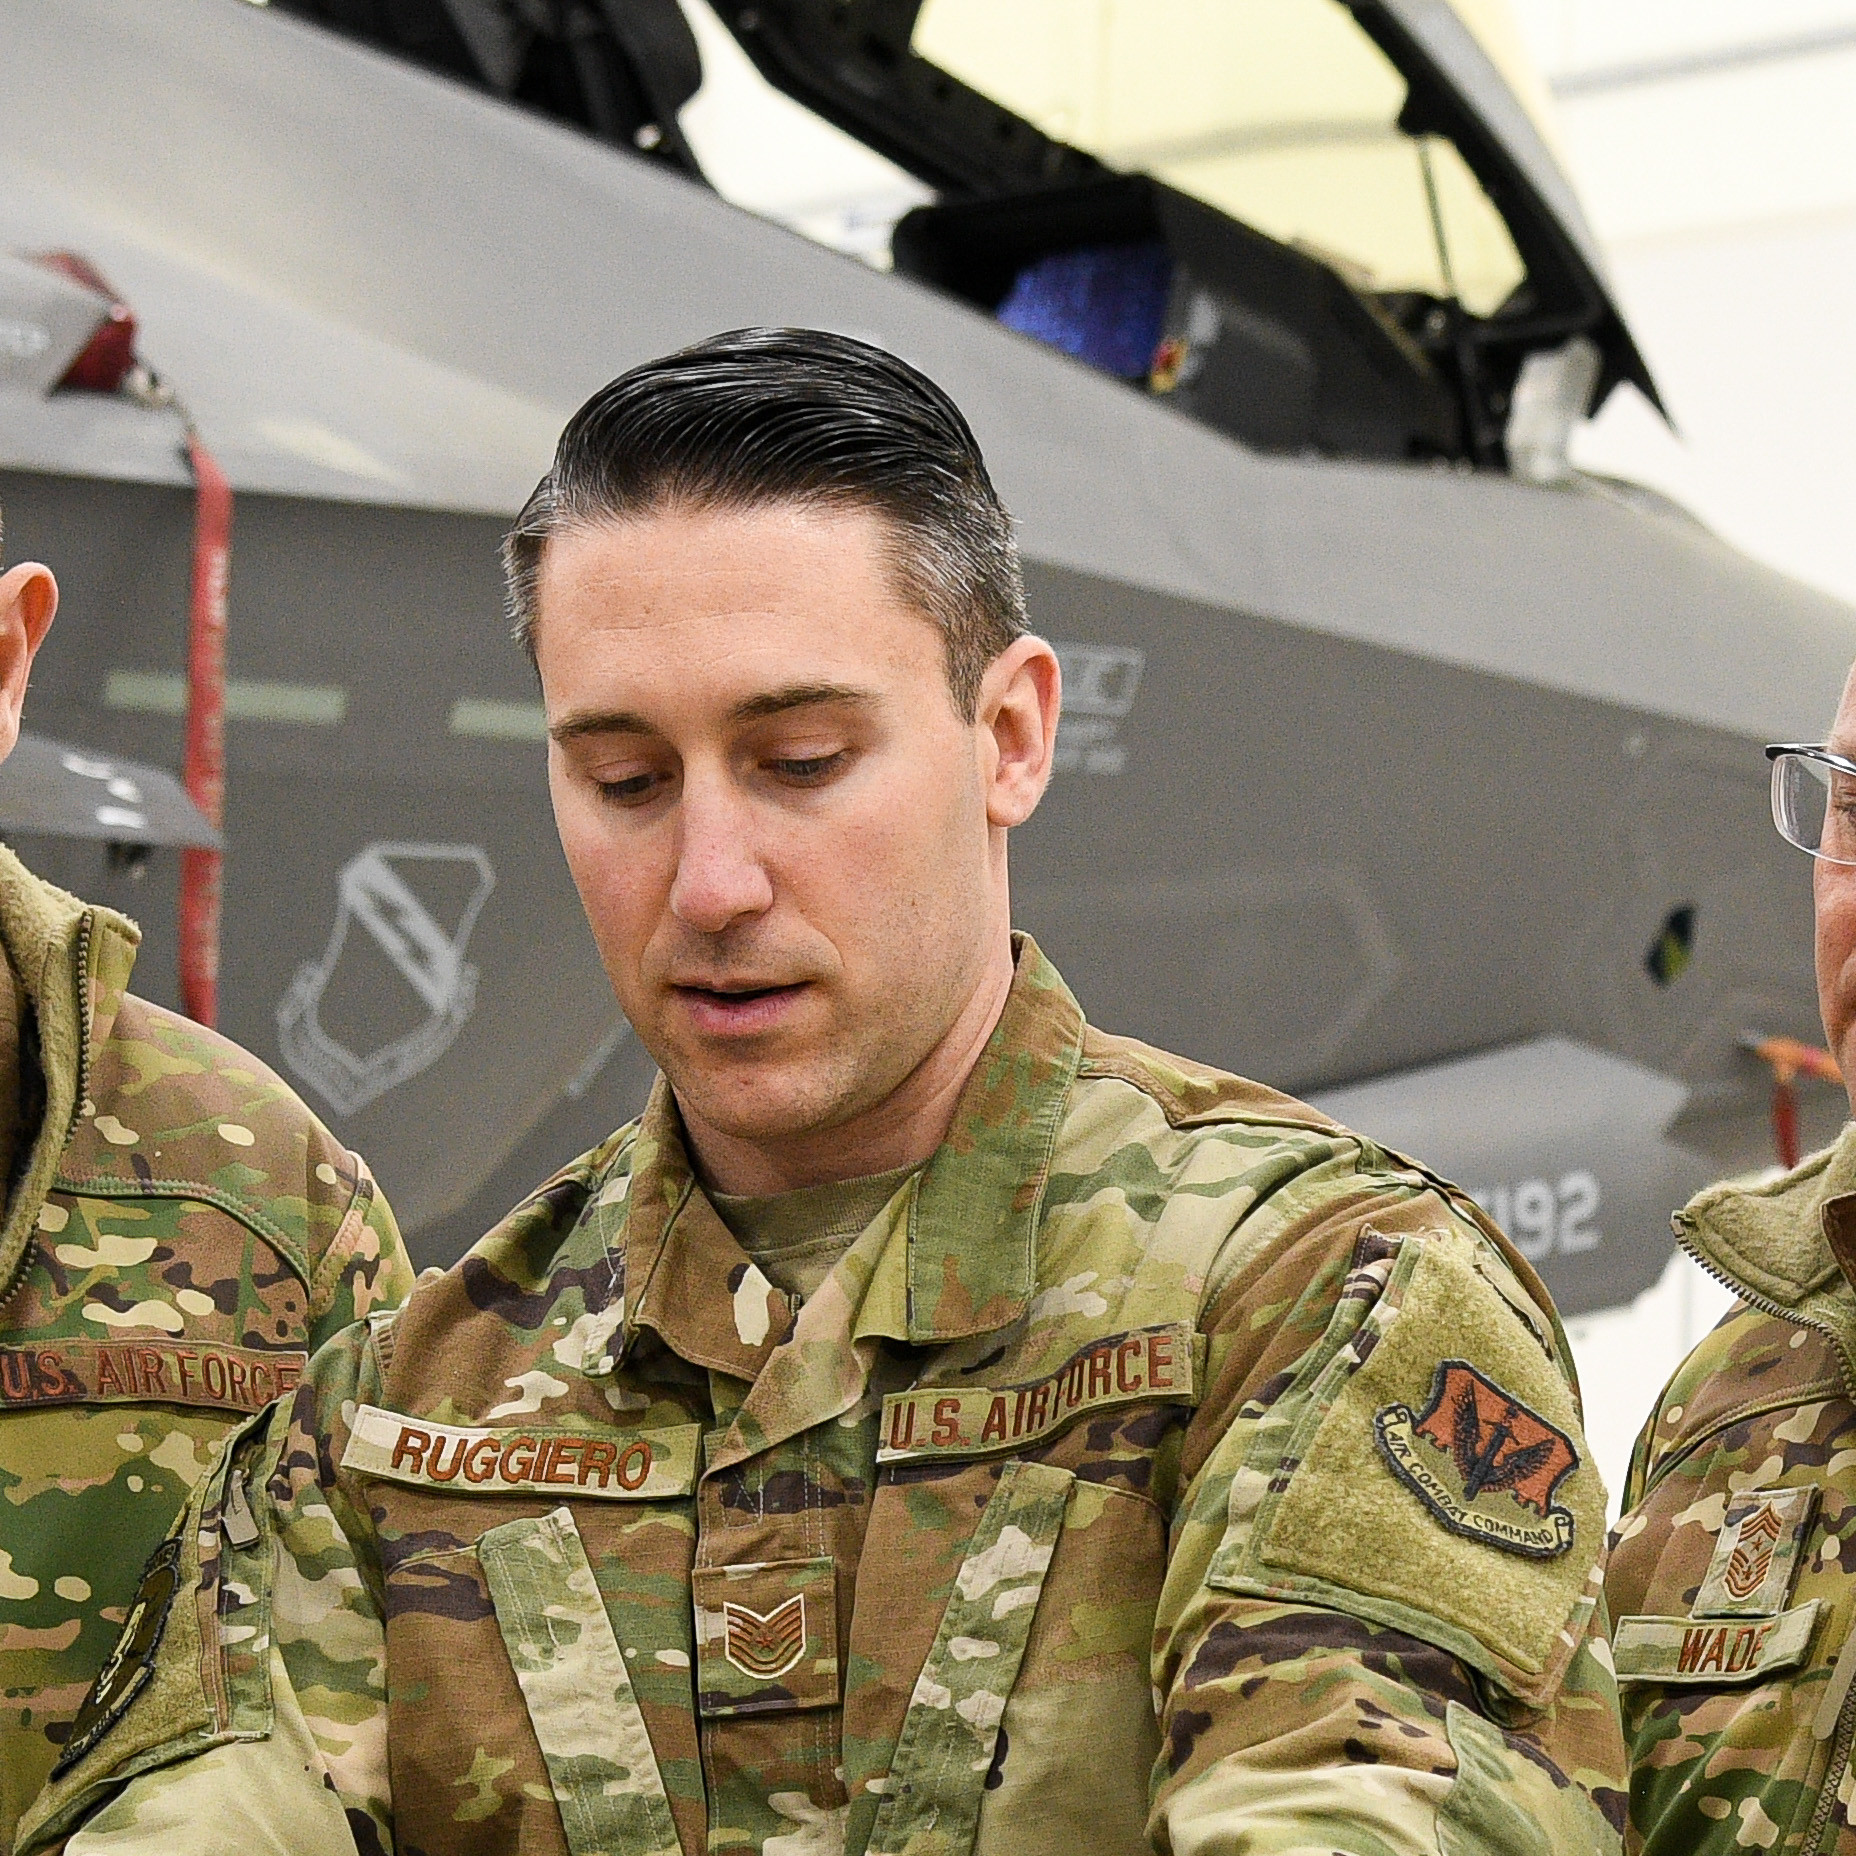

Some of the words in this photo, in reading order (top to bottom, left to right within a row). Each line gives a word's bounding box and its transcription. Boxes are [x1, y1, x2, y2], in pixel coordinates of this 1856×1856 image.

[1474, 1170, 1602, 1262] 192
[96, 1348, 168, 1397] AIR
[174, 1350, 302, 1408] FORCE
[889, 1398, 972, 1451] U.S.
[980, 1383, 1050, 1444] AIR
[1051, 1335, 1174, 1421] FORCE
[391, 1426, 652, 1491] RUGGIERO
[1388, 1431, 1412, 1460] AIR
[1408, 1462, 1467, 1523] COMBAT
[1472, 1514, 1555, 1546] COMMAND
[1676, 1622, 1776, 1674] WADE
